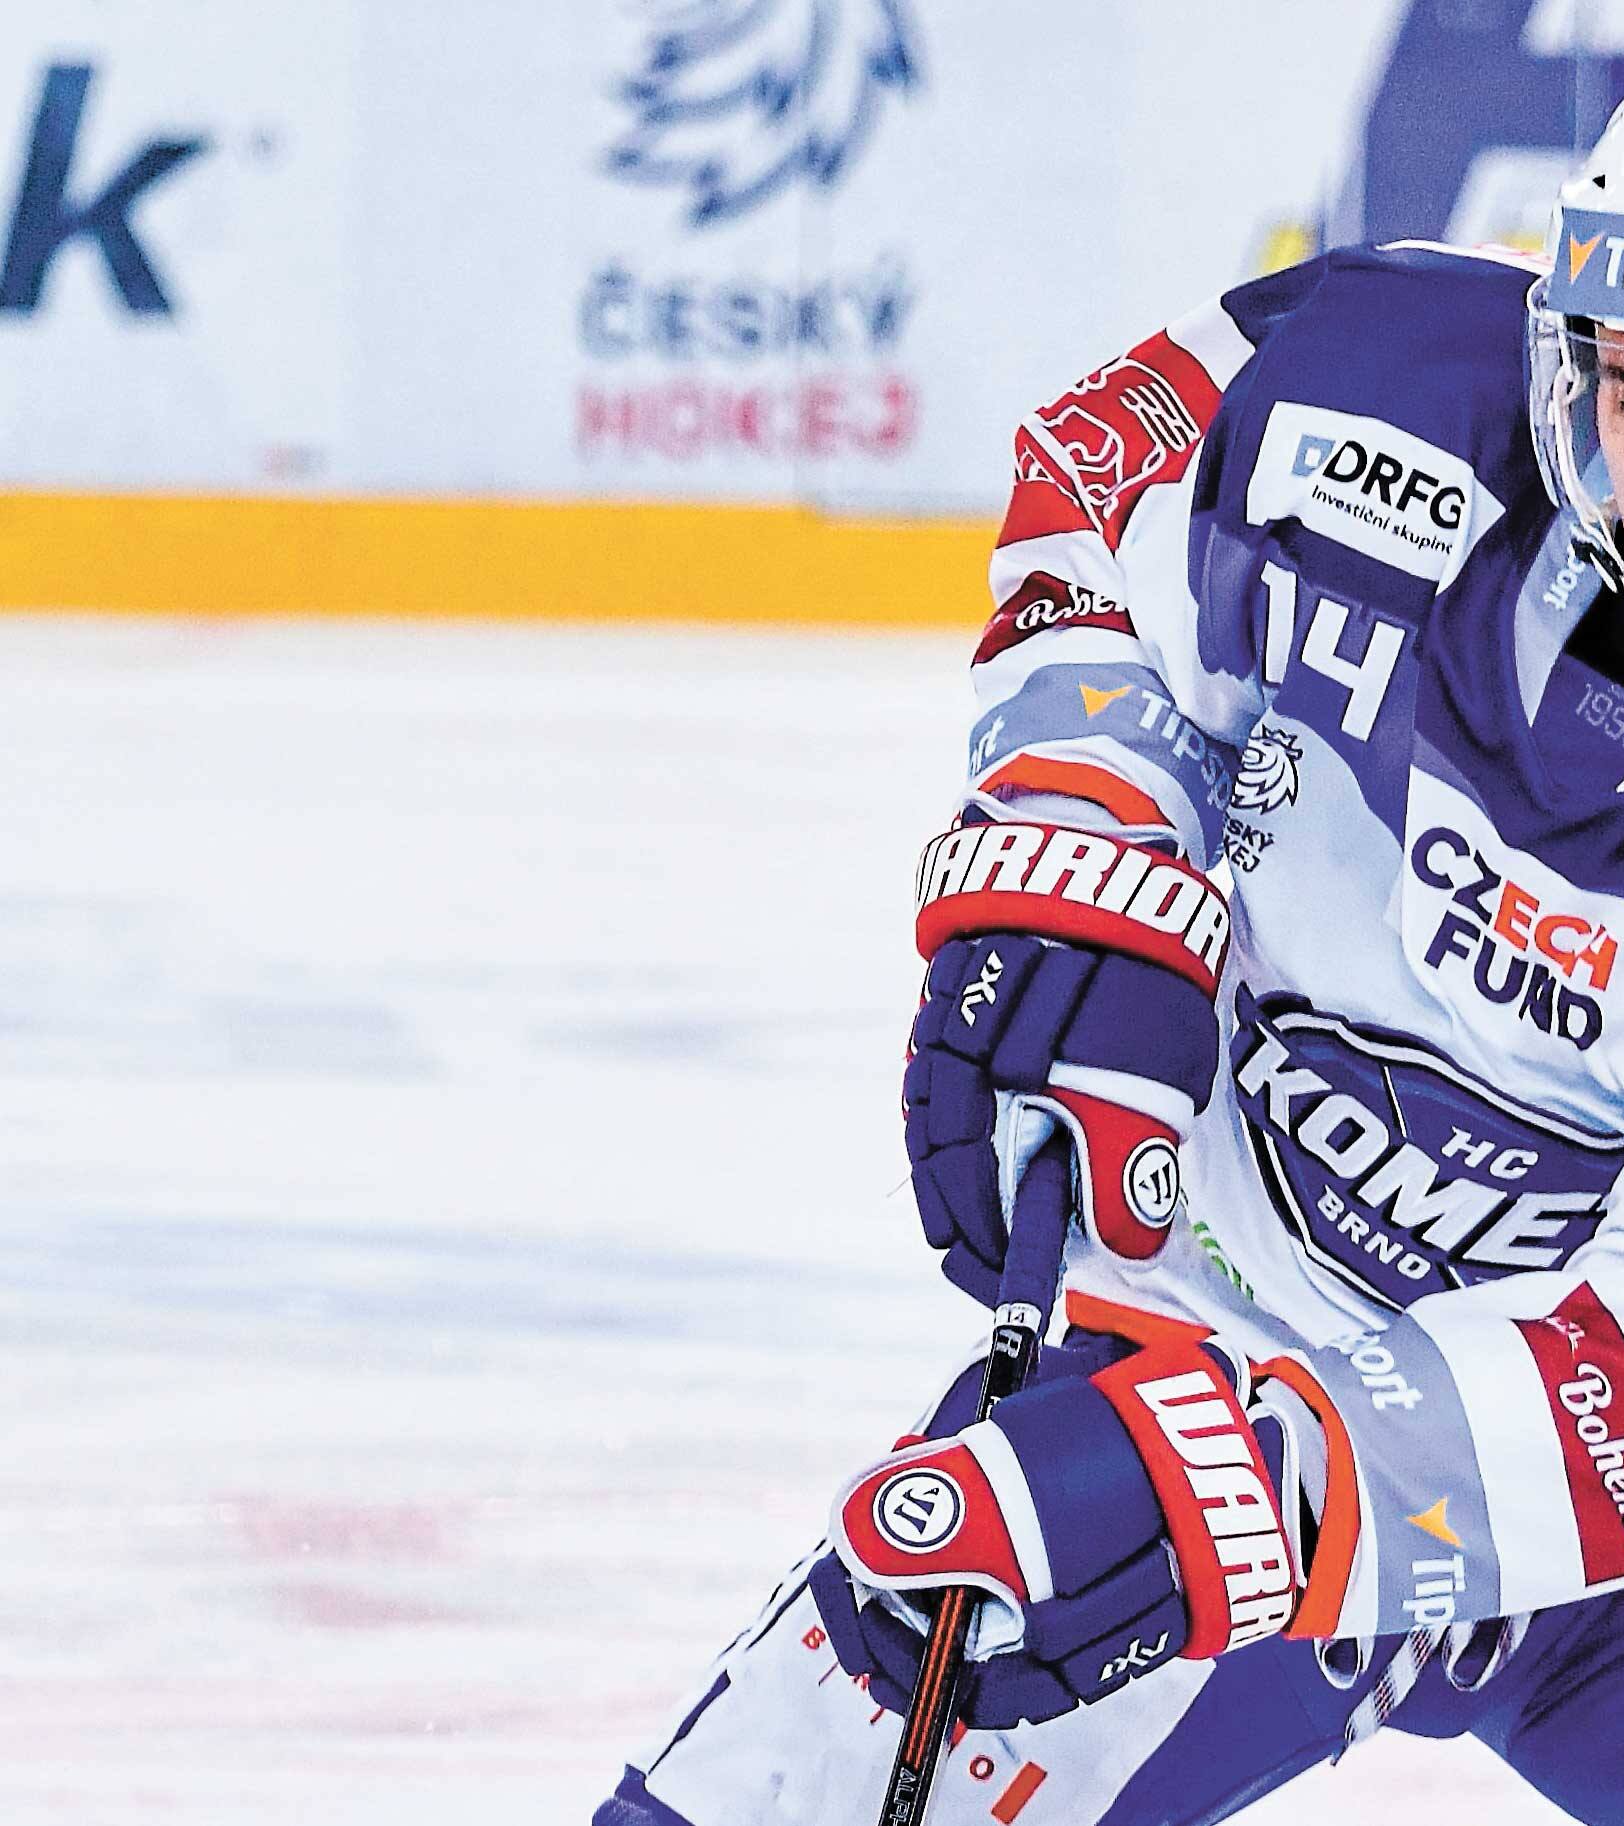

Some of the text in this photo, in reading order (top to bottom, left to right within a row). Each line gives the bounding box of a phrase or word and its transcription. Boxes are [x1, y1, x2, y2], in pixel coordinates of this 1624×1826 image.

[577, 375, 918, 462] HOKEJ
[1322, 440, 1466, 529] DRFG
[1261, 561, 1406, 742] 14
[1411, 826, 1618, 992] CZECH
[1424, 910, 1603, 1051] FUND
[1237, 1018, 1606, 1270] KOME
[1441, 1126, 1540, 1180] HC
[1316, 1185, 1432, 1281] BRNO
